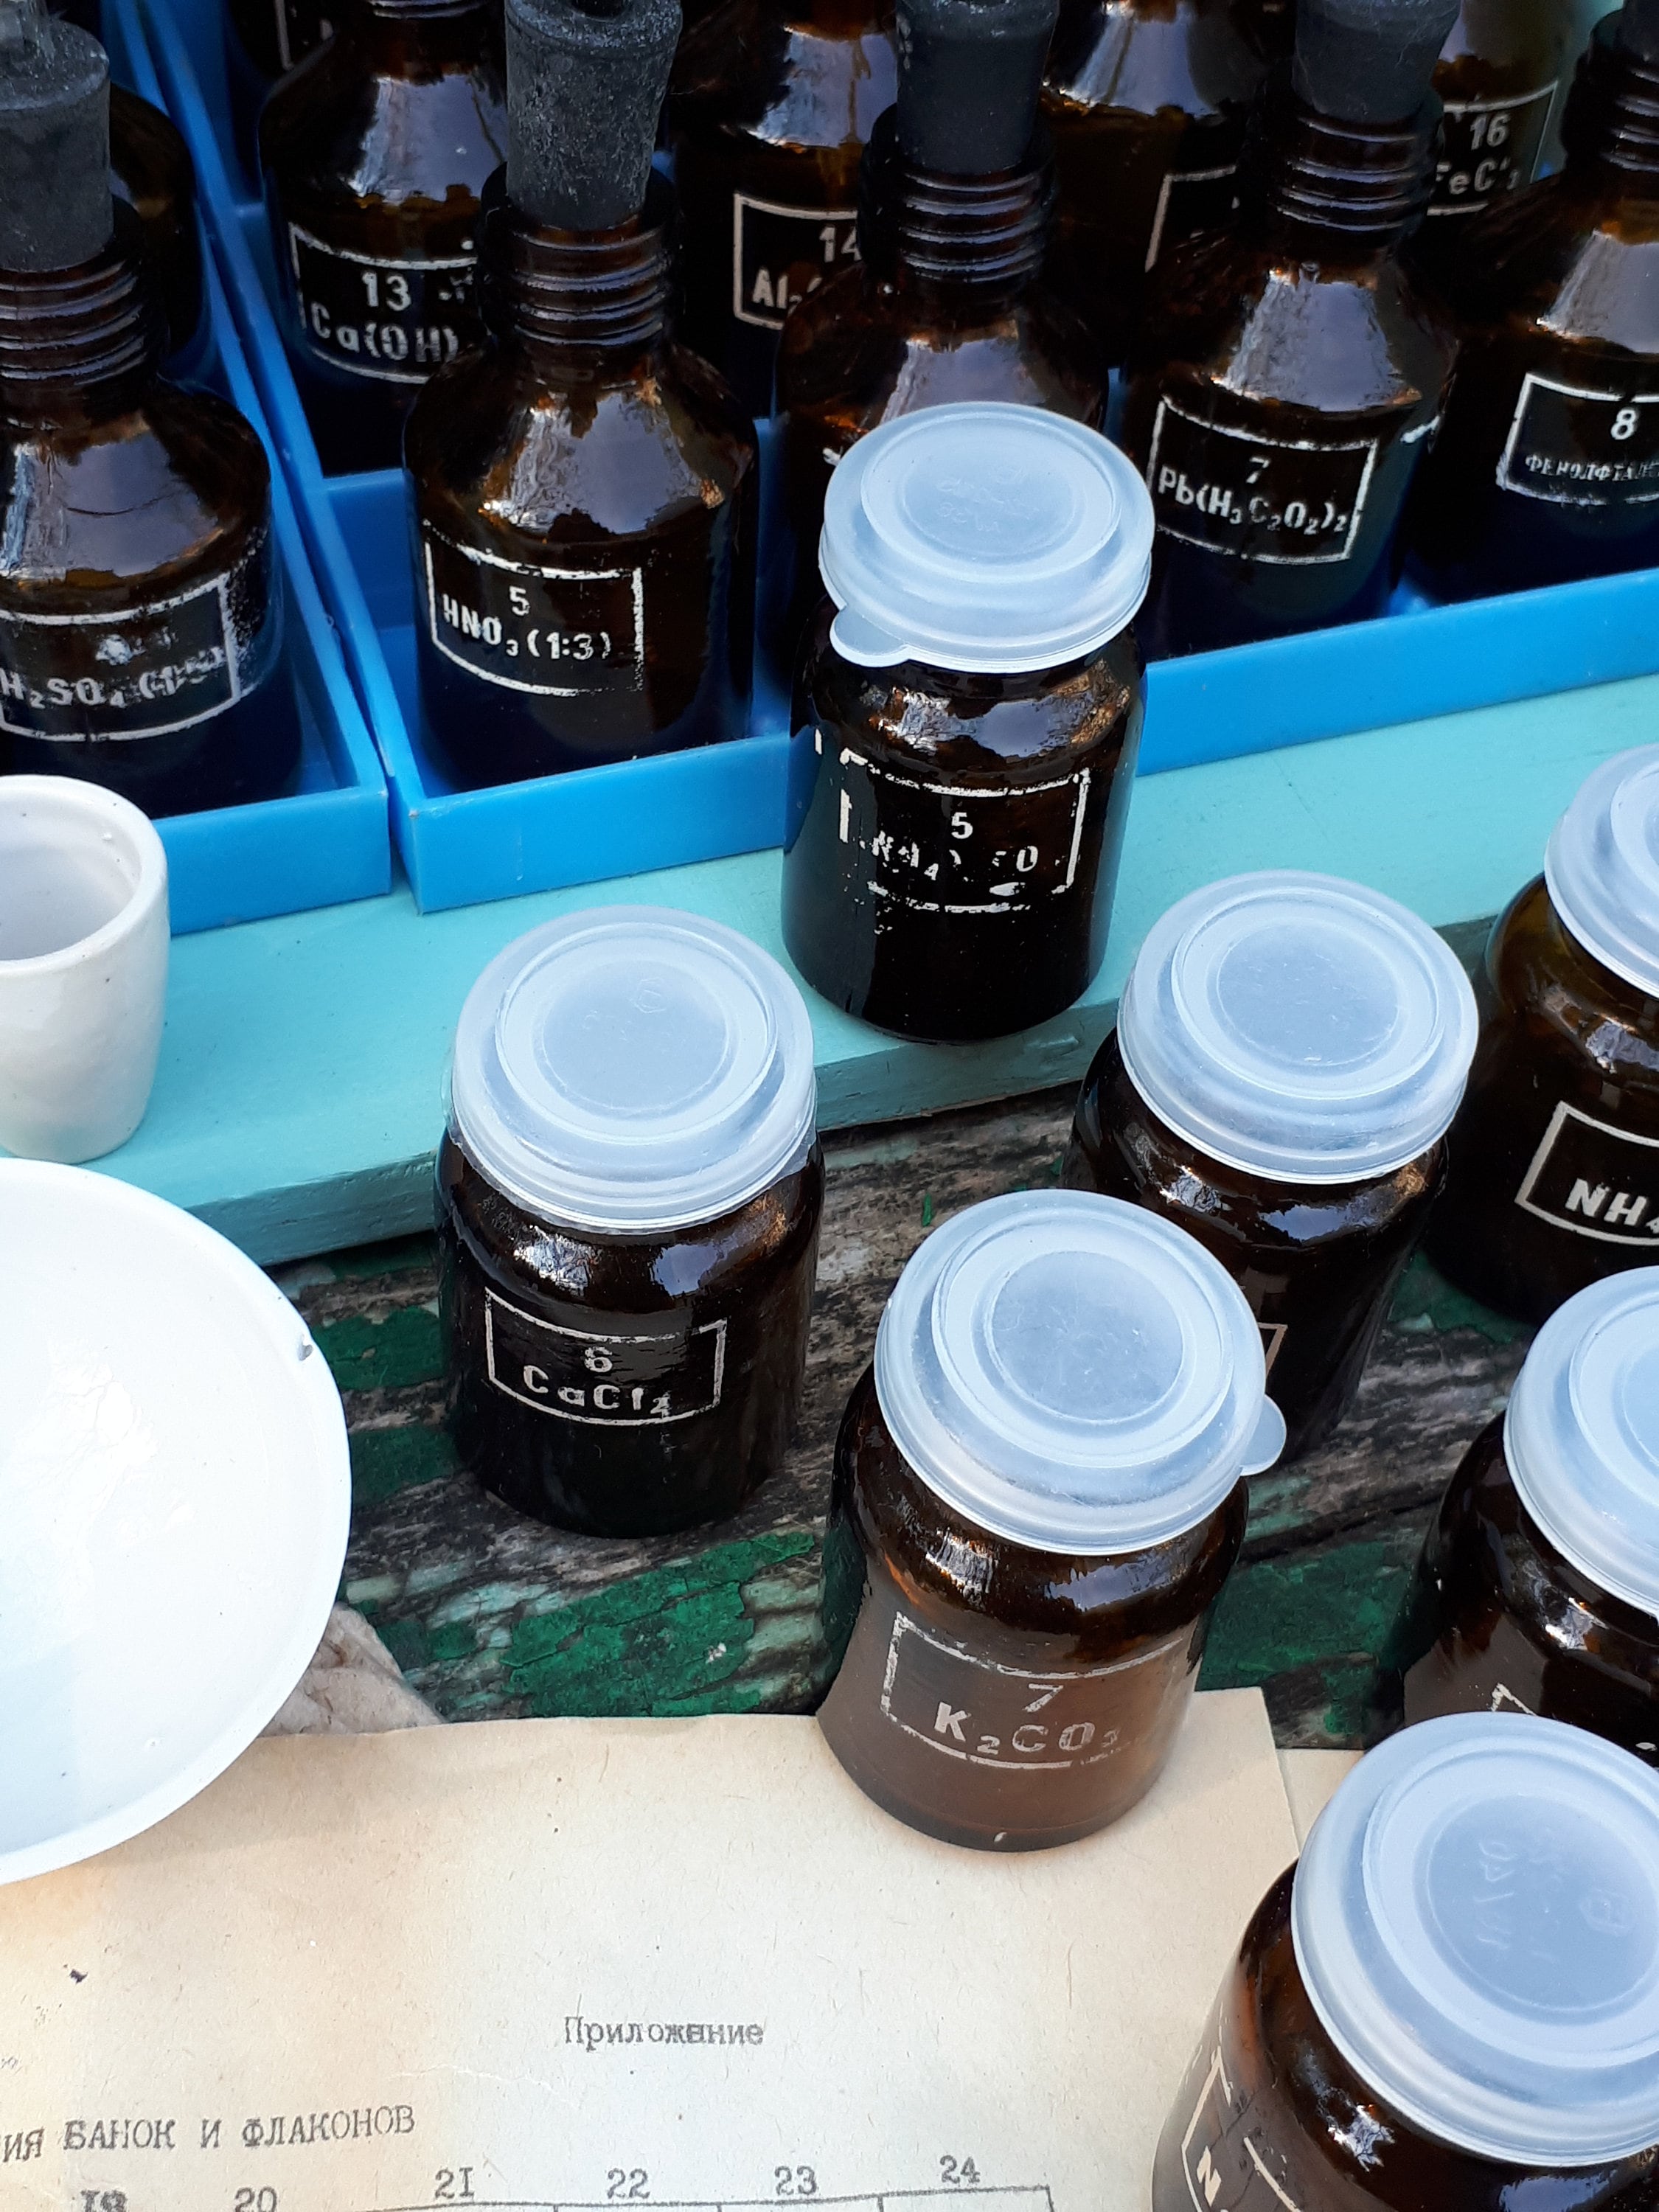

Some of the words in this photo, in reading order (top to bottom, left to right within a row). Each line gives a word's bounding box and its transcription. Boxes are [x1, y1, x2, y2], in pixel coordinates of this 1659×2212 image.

[1470, 113, 1509, 150] 16
[818, 226, 862, 262] 14
[361, 271, 411, 311] 13
[1610, 408, 1638, 441] 8
[1246, 456, 1270, 484] 7
[509, 585, 530, 616] 5
[951, 812, 973, 839] 5
[584, 1346, 613, 1373] 6
[1023, 1683, 1063, 1713] 7
[934, 1701, 1121, 1755] K2CO3
[564, 2015, 764, 2053] Приложение
[63, 2118, 175, 2150] БАНОК
[200, 2118, 222, 2149] И
[242, 2104, 415, 2148] ФЛАКОНОВ
[607, 2168, 651, 2199] 22
[774, 2165, 818, 2196] 23
[940, 2154, 981, 2185] 24
